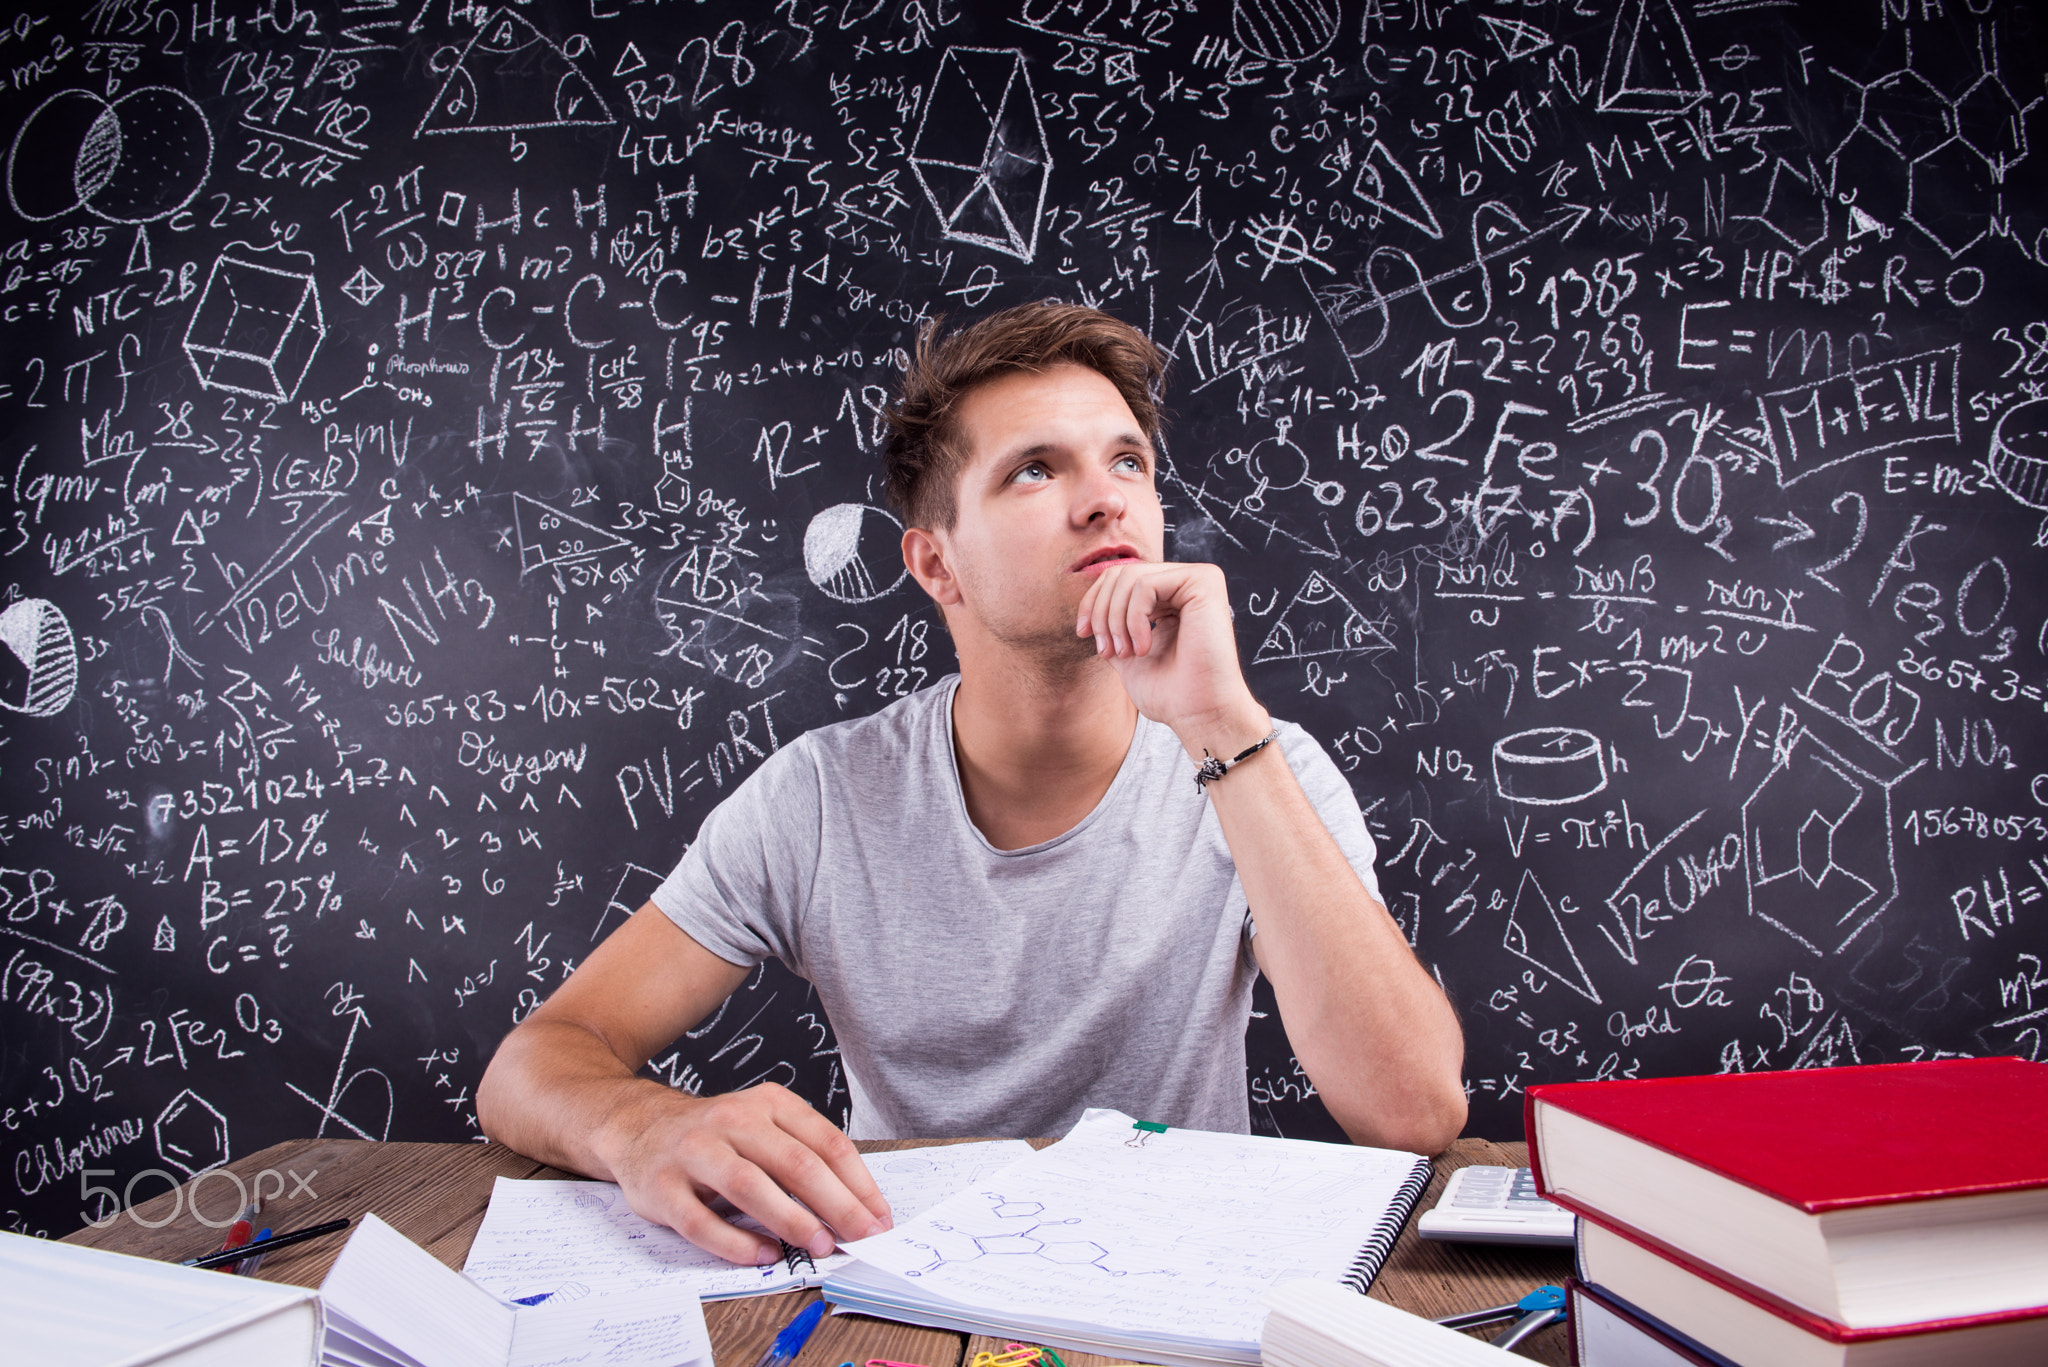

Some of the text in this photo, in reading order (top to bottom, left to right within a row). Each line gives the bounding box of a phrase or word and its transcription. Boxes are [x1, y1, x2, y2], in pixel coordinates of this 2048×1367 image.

[1052, 39, 1102, 76] 28
[1799, 45, 1815, 86] F
[1041, 91, 1101, 121] 35
[510, 132, 528, 163] b
[1457, 160, 1483, 197] b
[1806, 153, 1839, 201] N
[1703, 173, 1726, 236] N
[1312, 224, 1334, 252] b
[433, 248, 487, 280] 829
[1507, 255, 1533, 297] 5
[691, 320, 731, 357] 95
[520, 388, 556, 415] 56
[154, 400, 194, 440] 38
[539, 514, 562, 531] 60
[557, 539, 587, 556] 30
[883, 613, 929, 666] 18
[1416, 746, 1477, 783] NO2
[1609, 740, 1629, 773] h
[435, 826, 543, 854] 2 3 4
[441, 868, 506, 896] 3 6
